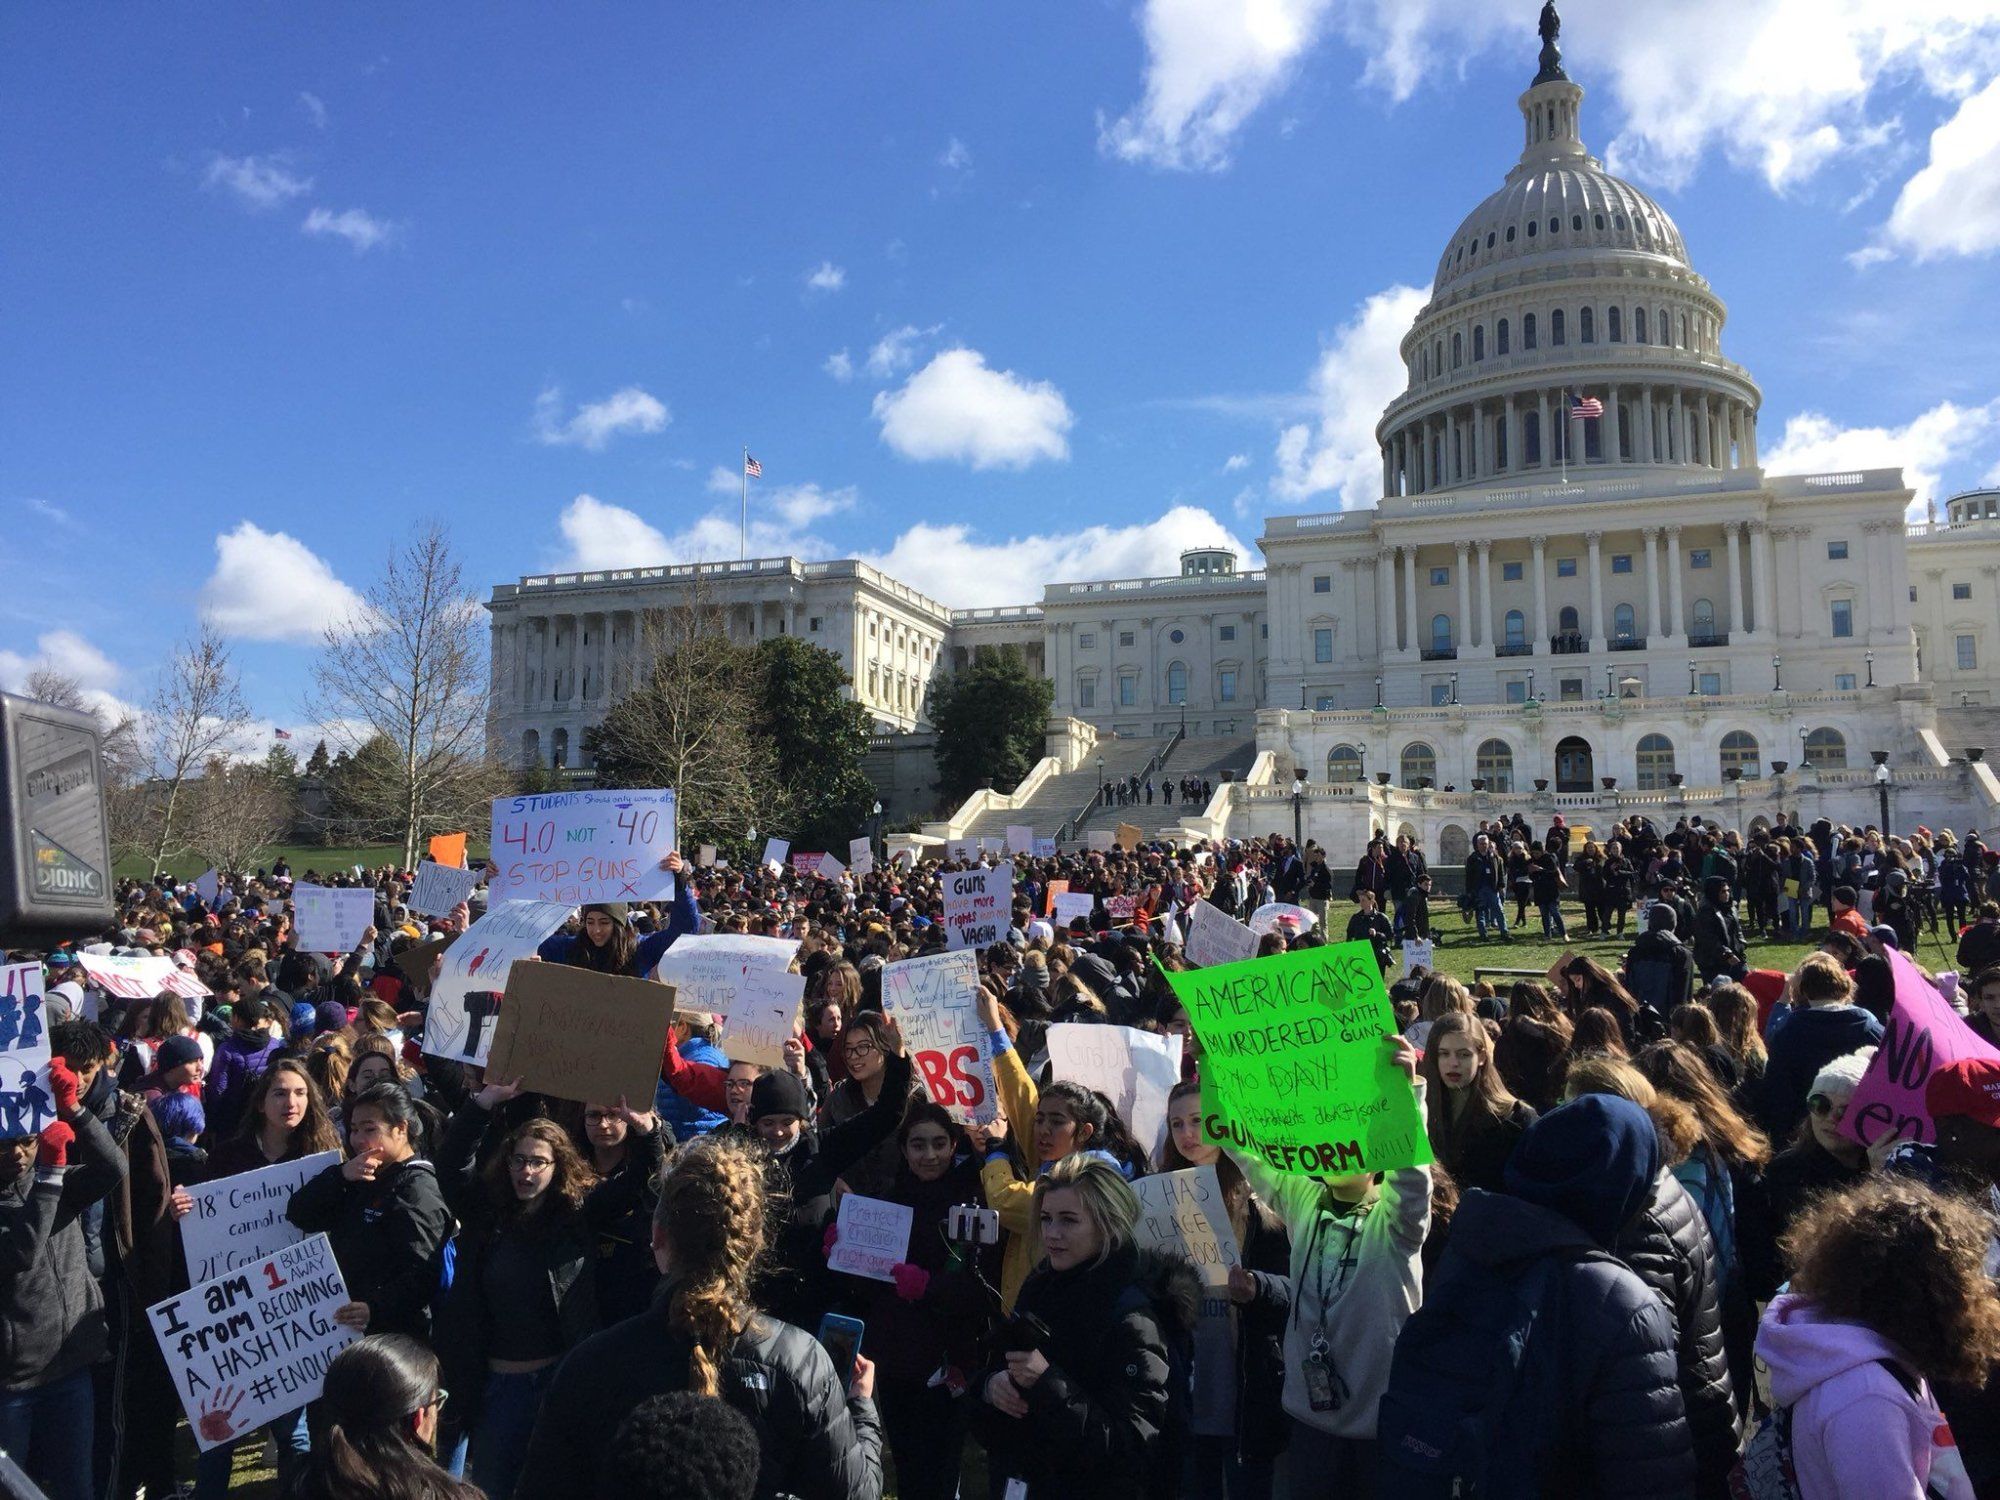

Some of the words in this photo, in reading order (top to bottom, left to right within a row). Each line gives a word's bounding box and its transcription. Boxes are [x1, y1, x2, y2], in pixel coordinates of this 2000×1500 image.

[511, 793, 580, 814] STUDENTS
[613, 795, 631, 804] only
[504, 821, 555, 854] 4.0
[566, 827, 597, 843] NOT
[610, 810, 659, 846] .40
[508, 860, 570, 886] STOP
[578, 857, 642, 882] GUNS
[954, 875, 985, 895] Guns
[974, 896, 995, 908] more
[949, 911, 977, 929] rights
[961, 925, 996, 945] VAGINA
[676, 984, 728, 1006] SSAULT
[892, 966, 972, 1010] WE
[1195, 957, 1374, 1020] AMERICANS
[1203, 1018, 1328, 1058] MURDERED
[1333, 1003, 1380, 1025] WITH
[1340, 1022, 1386, 1043] GUNS
[914, 1045, 985, 1107] BS
[229, 1182, 294, 1209] Century
[1162, 1176, 1209, 1206] HAS
[229, 1209, 275, 1236] cannot
[1145, 1213, 1207, 1241] PLACE
[280, 1237, 326, 1269] BULLET
[290, 1256, 325, 1282] AWAY
[156, 1300, 189, 1337] I
[204, 1274, 254, 1315] am
[263, 1262, 288, 1291] 1
[177, 1311, 255, 1360] from
[258, 1273, 344, 1325] BECOMING
[185, 1367, 211, 1397] A
[212, 1310, 338, 1382] HASHTAG.
[250, 1337, 353, 1405] #ENOUG
